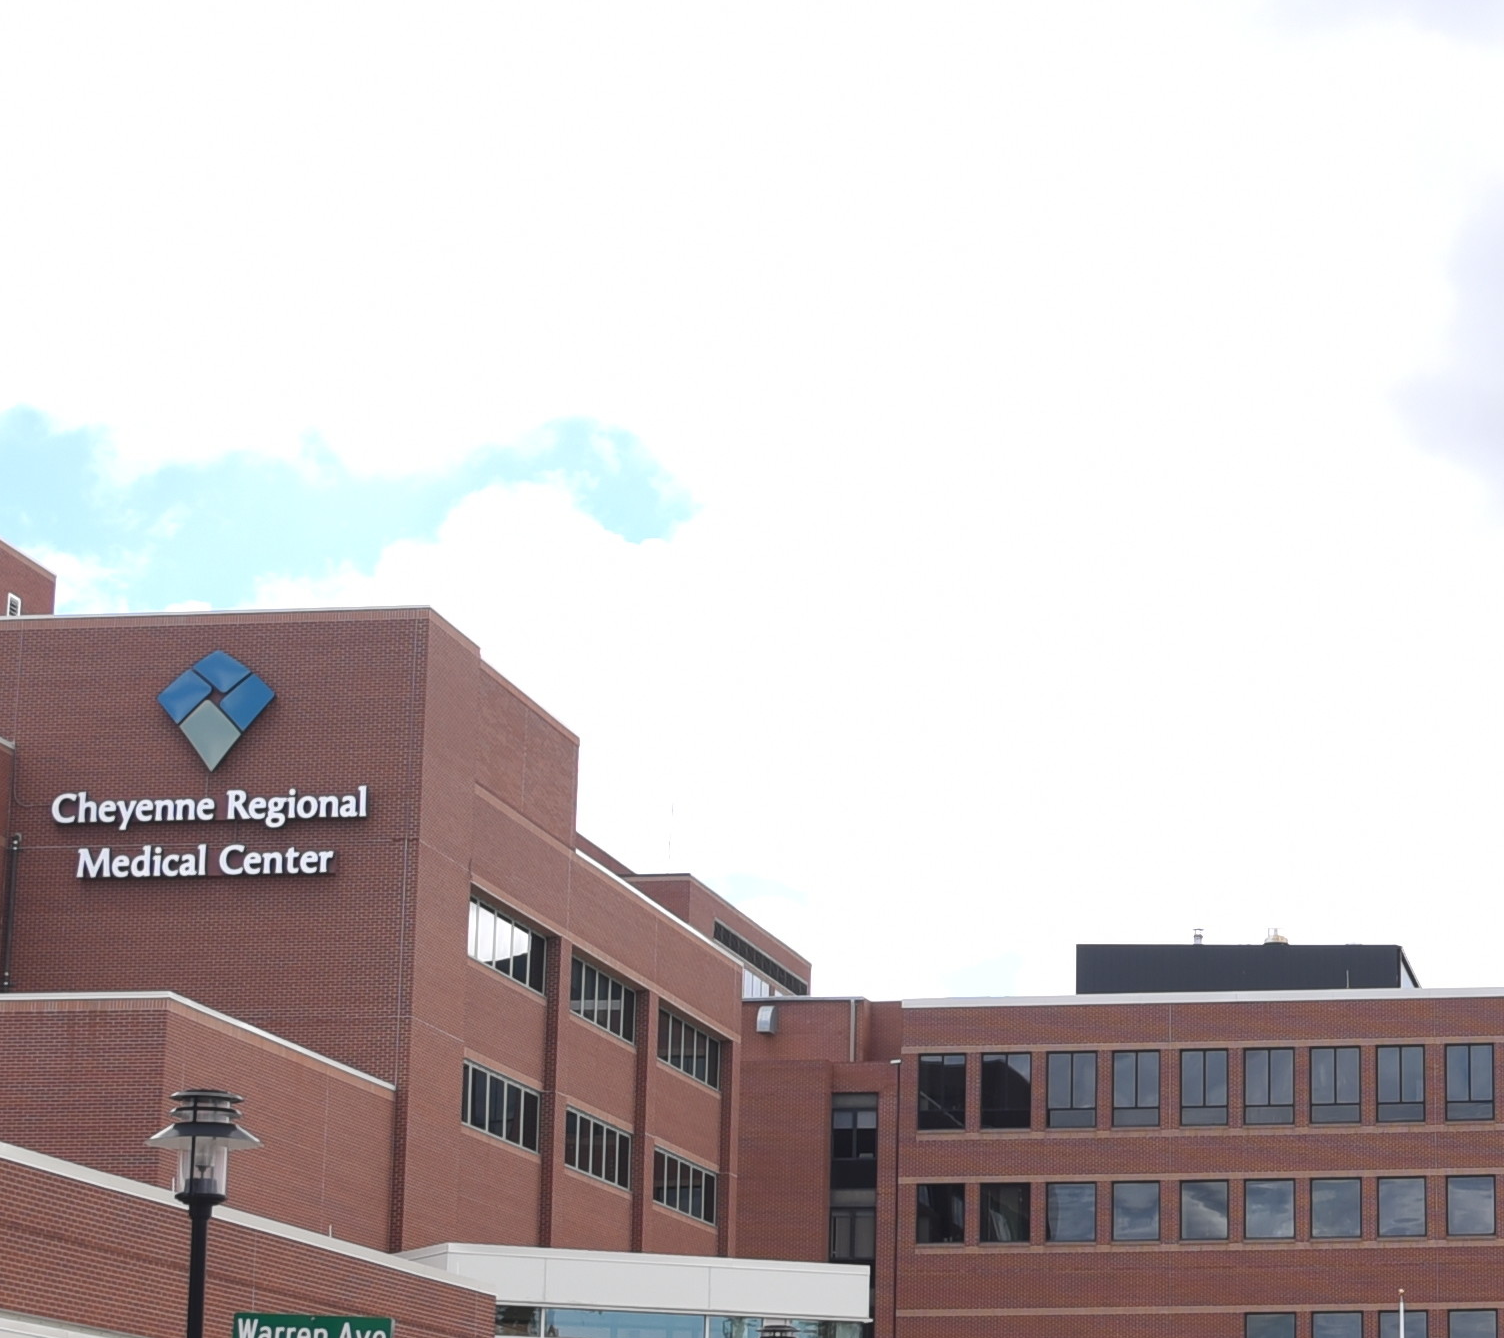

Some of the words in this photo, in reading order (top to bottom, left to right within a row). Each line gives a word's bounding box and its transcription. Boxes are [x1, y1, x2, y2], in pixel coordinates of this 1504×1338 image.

[51, 791, 215, 830] Cheyenne
[226, 785, 368, 828] Regional
[76, 843, 208, 879] Medical
[219, 844, 335, 876] Center
